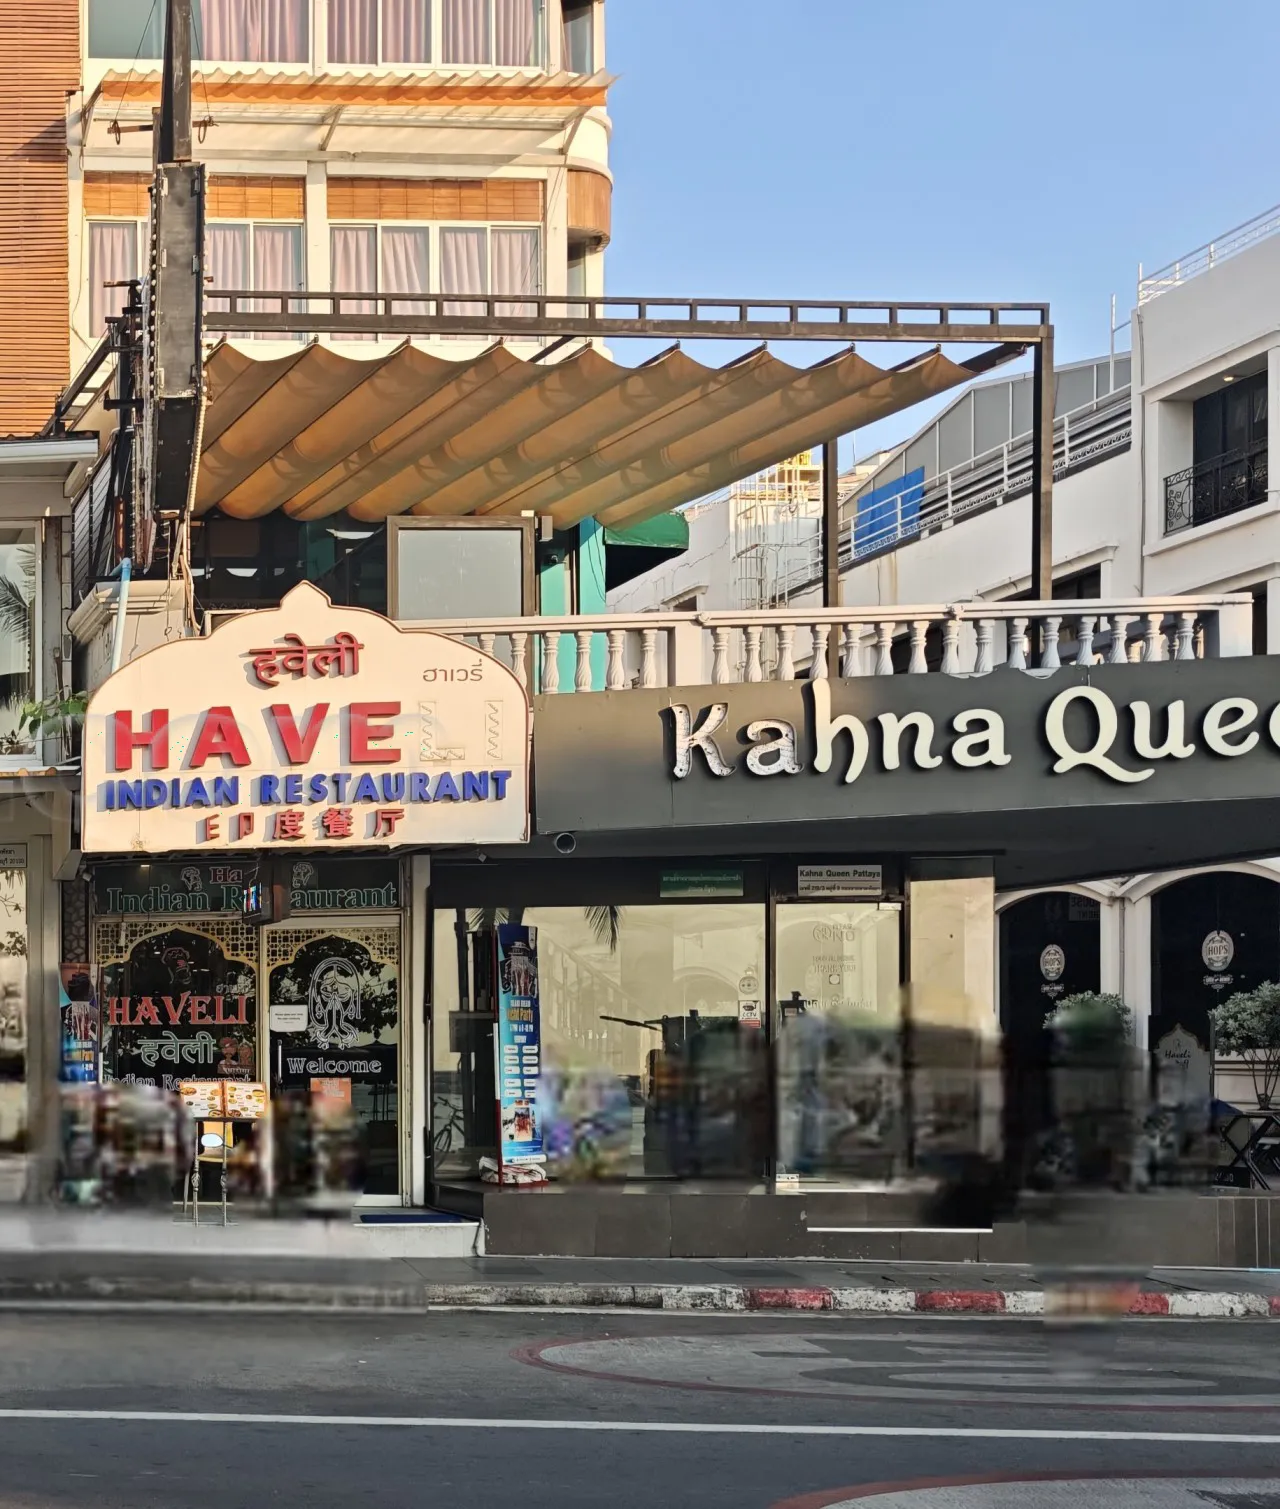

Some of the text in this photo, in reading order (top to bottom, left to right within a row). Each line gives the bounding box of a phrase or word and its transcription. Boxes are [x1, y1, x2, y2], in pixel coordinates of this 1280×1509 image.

[248, 632, 364, 686] हवेली
[423, 658, 483, 682] ฮาเวรี่
[670, 678, 1280, 784] Kahna Que
[106, 770, 512, 811] INDIAN RESTAURANT
[800, 869, 881, 878] Kahna Queen Pattaya
[106, 883, 211, 914] Indian
[221, 881, 397, 912] Raurant
[1207, 945, 1229, 956] HOPS
[108, 991, 248, 1026] HAVELI
[138, 1031, 218, 1068] हवेली
[287, 1057, 382, 1074] Welcome
